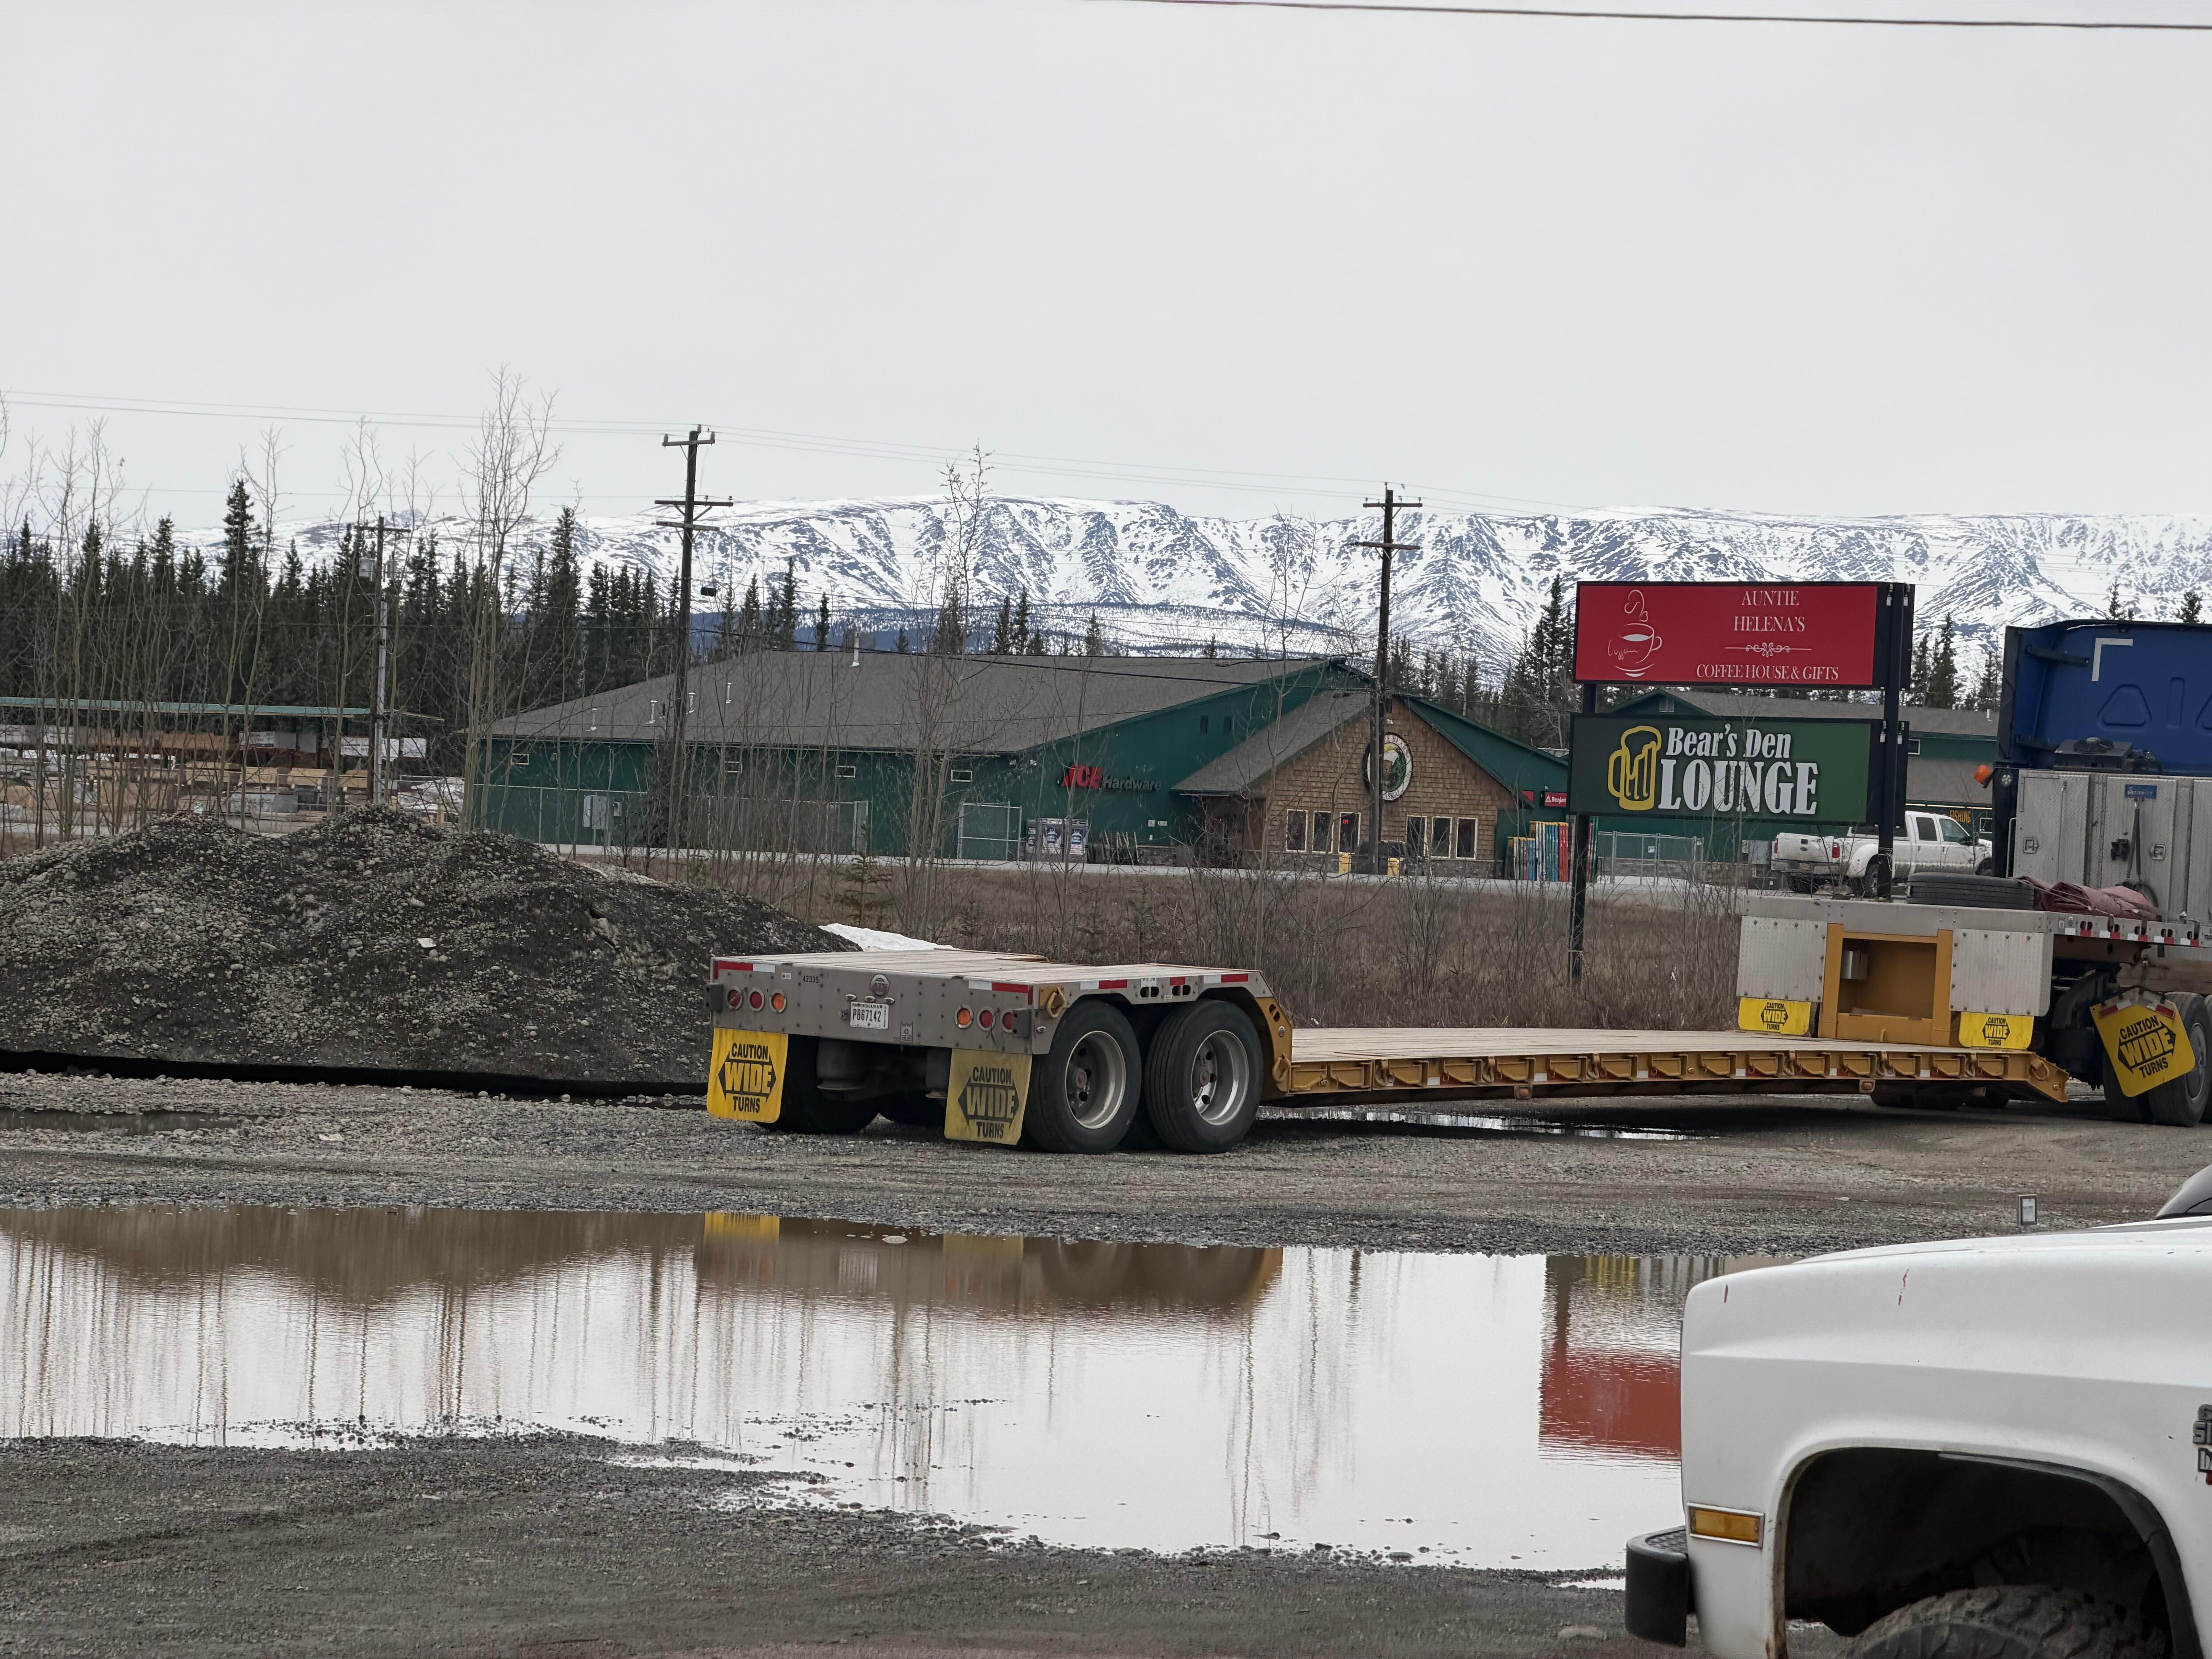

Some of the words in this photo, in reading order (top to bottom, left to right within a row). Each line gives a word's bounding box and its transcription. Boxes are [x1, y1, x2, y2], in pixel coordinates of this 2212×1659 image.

[1741, 590, 1799, 606] AUNTIE
[1734, 616, 1805, 632] HELENA'S
[1696, 664, 1743, 678] COFFEE
[1746, 664, 1789, 680] HOUSE
[1790, 666, 1800, 680] &
[1802, 666, 1839, 680] GIFTS
[1665, 723, 1738, 757] Bear's
[1743, 729, 1792, 758] Den
[1062, 764, 1103, 788] ACE
[1101, 775, 1162, 791] Hardware
[1658, 759, 1818, 814] LOUNGE
[1950, 810, 1971, 823] FISHING
[853, 1008, 881, 1022] PB67142
[1763, 1010, 1786, 1023] WIDE
[1985, 1025, 2008, 1038] WIDE
[2119, 1015, 2159, 1040] CAUTION
[731, 1042, 768, 1060] CAUTION
[2120, 1027, 2174, 1067] WIDE
[973, 1066, 1012, 1085] CAUTION
[2139, 1057, 2169, 1078] TURNS
[725, 1061, 772, 1094] WIDE
[733, 1096, 760, 1114] TURNS
[966, 1086, 1016, 1119] WIDE
[976, 1121, 1005, 1140] TURNS
